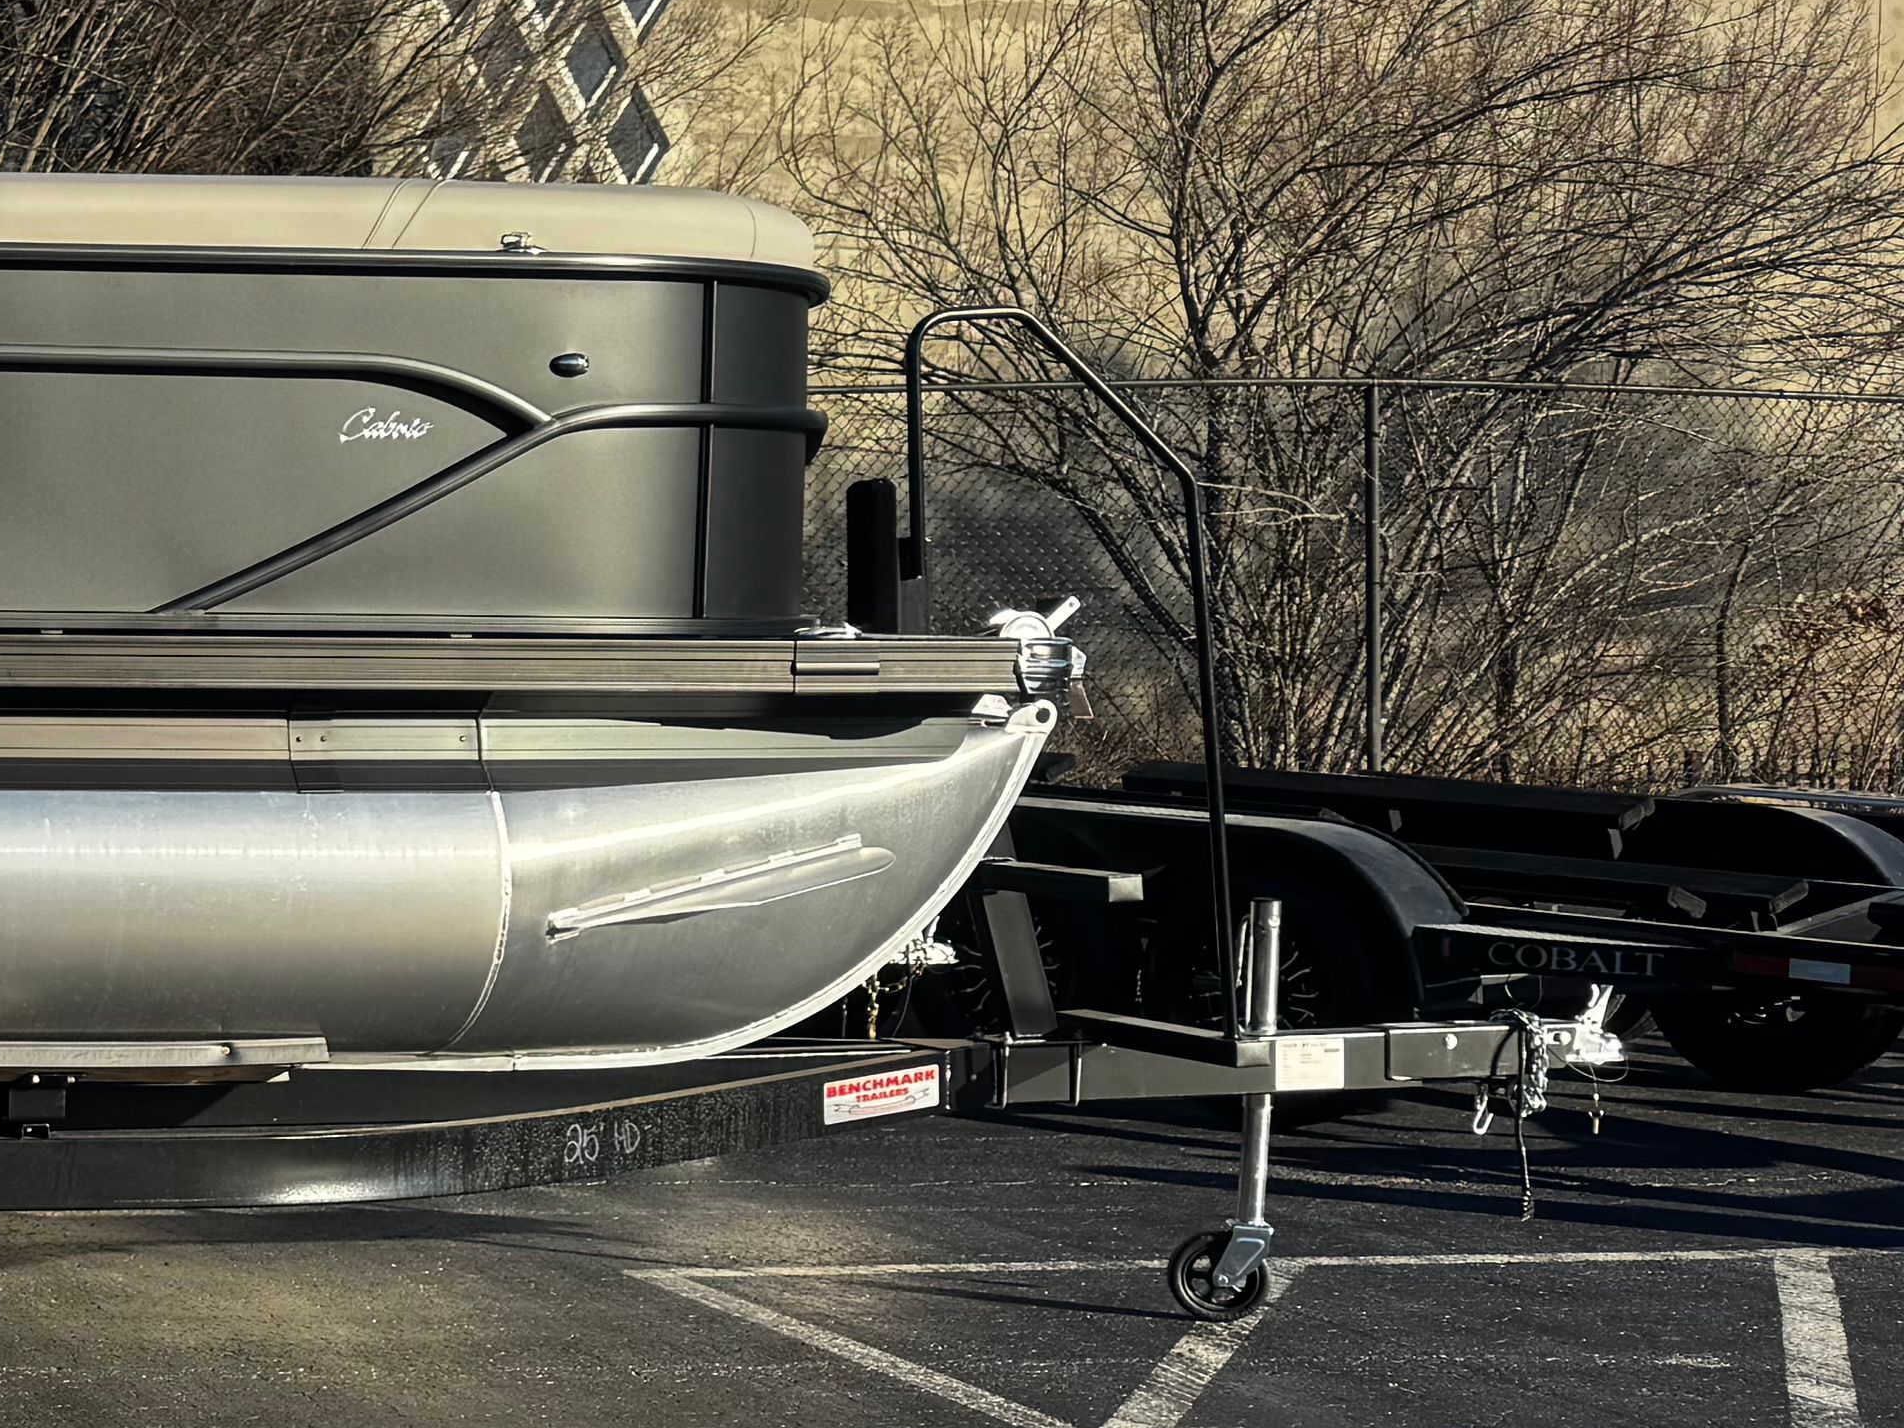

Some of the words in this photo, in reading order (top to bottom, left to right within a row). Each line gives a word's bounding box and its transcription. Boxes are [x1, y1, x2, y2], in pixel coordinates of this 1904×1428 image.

[1488, 941, 1665, 977] COBALT
[826, 1069, 935, 1098] BENCHMARK
[855, 1087, 909, 1103] TRAILERS
[614, 1119, 641, 1153] HD
